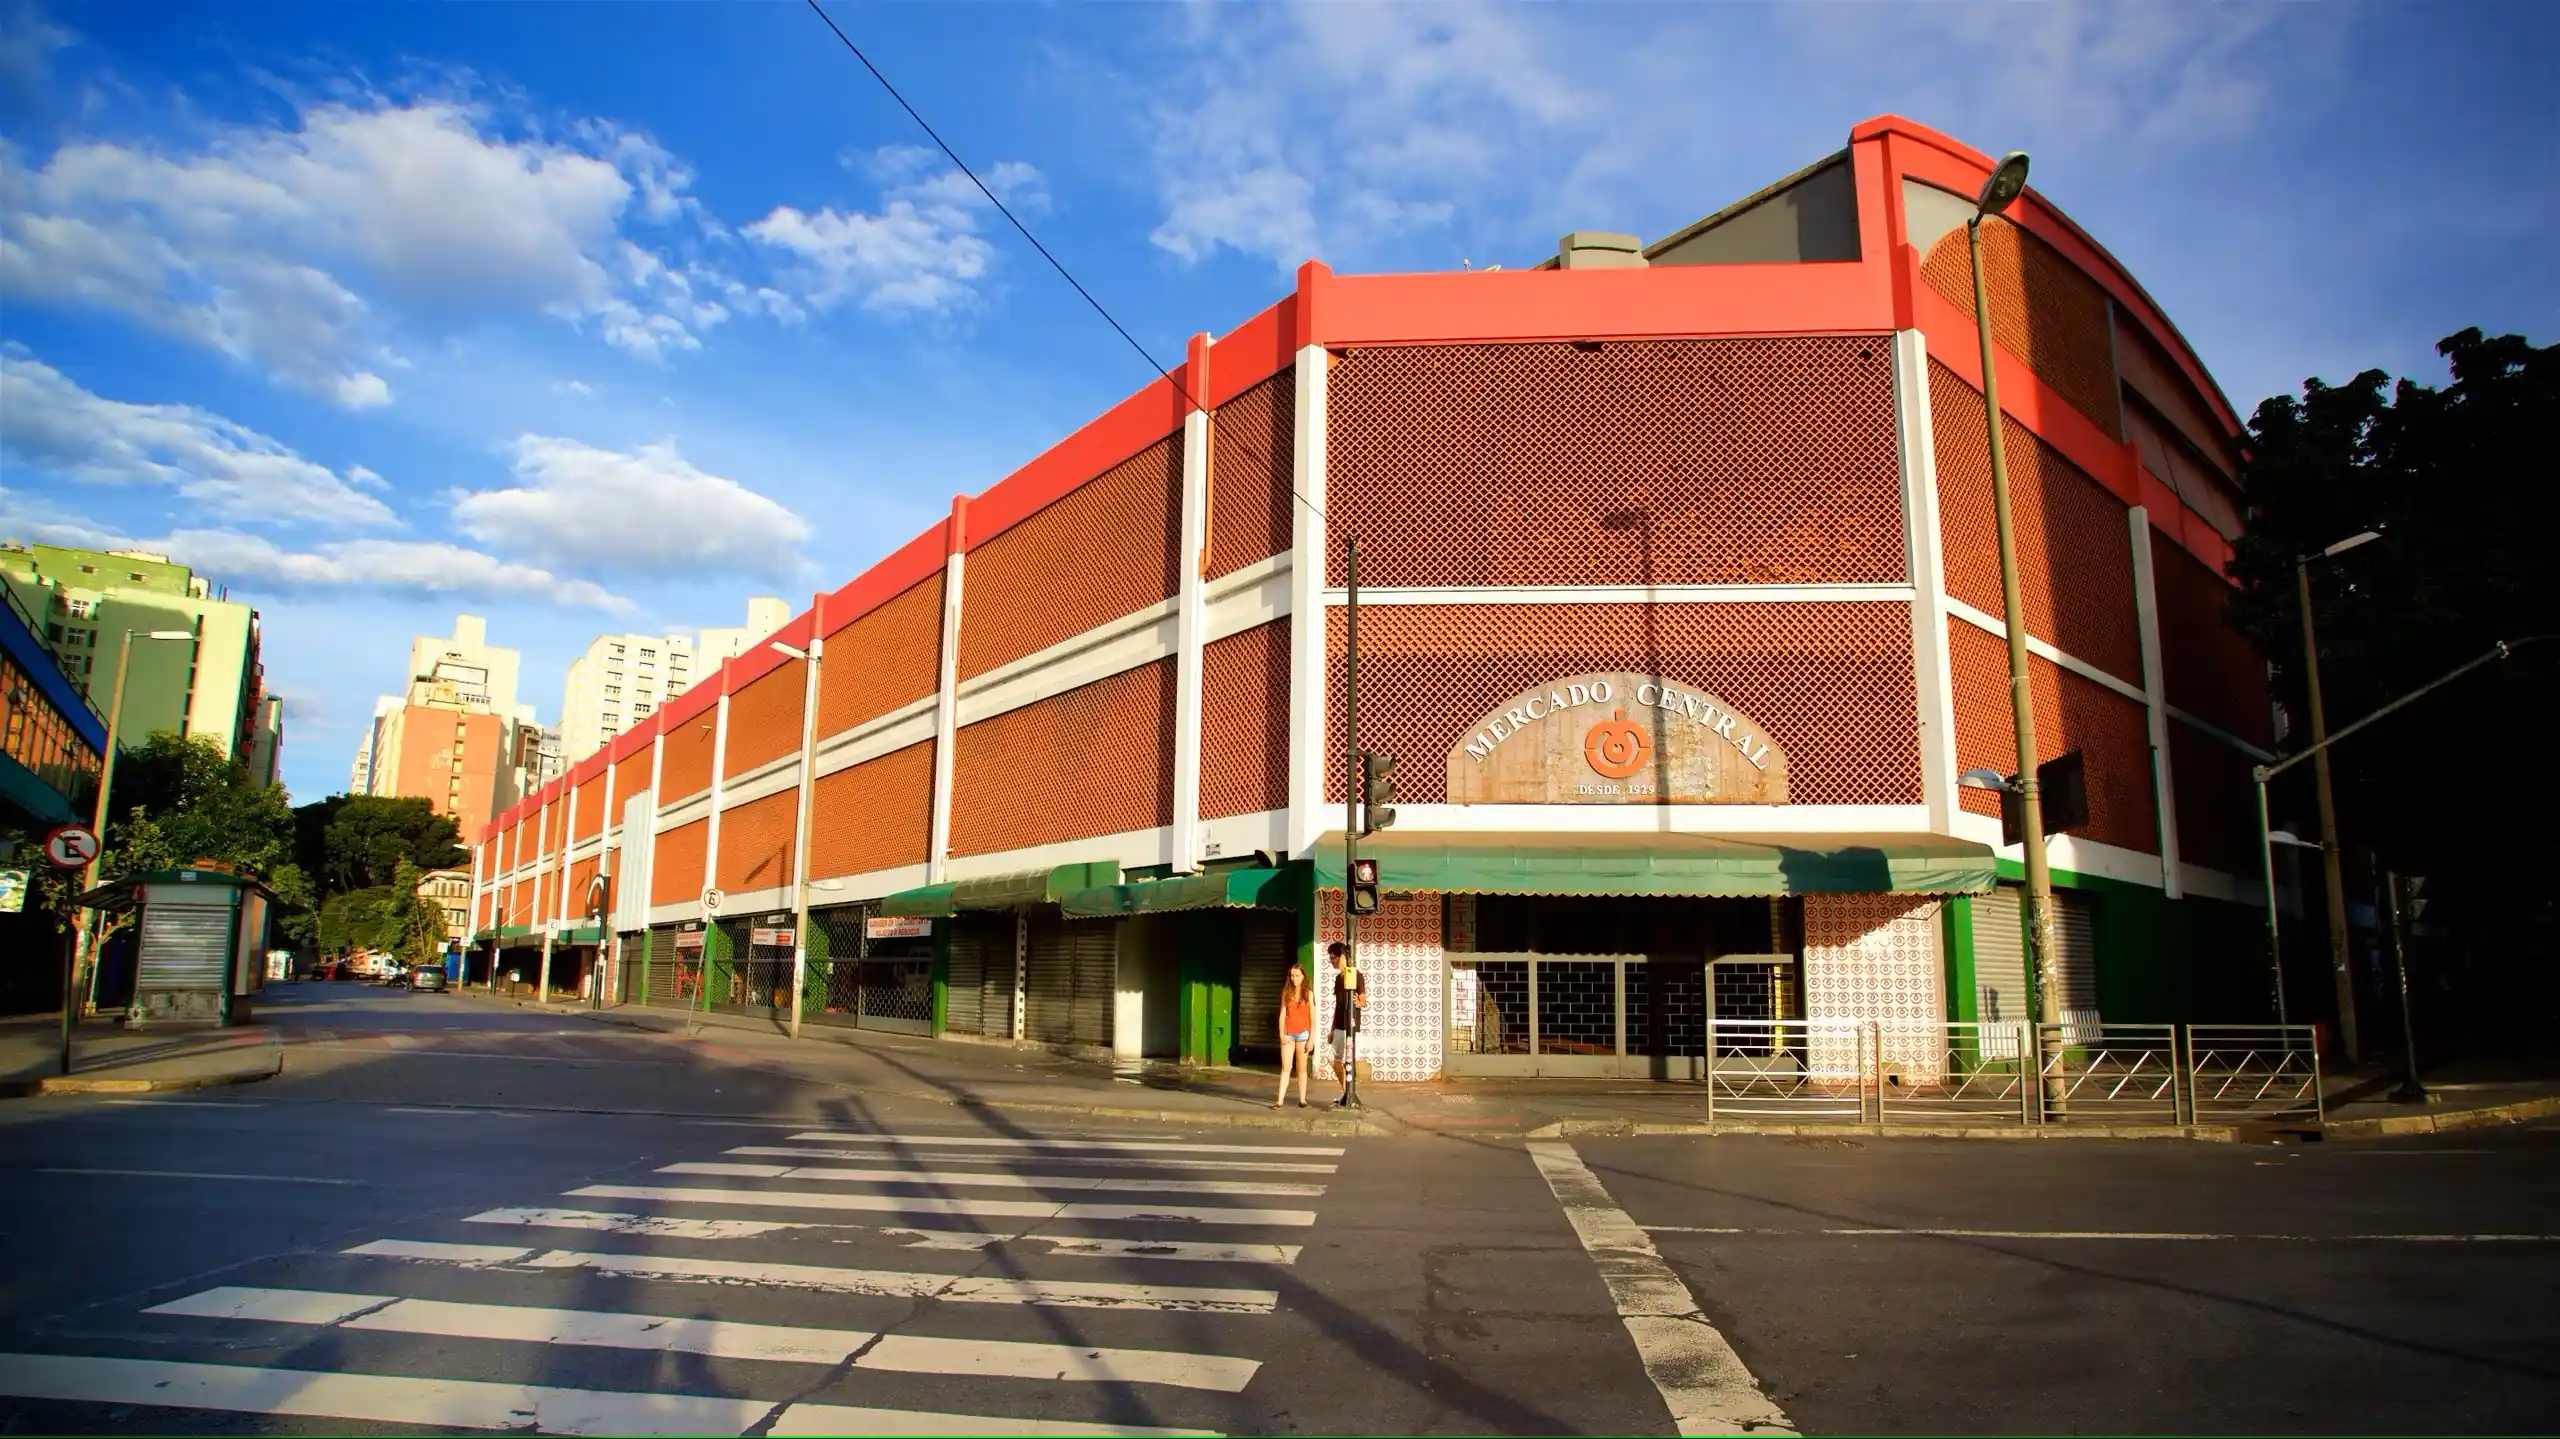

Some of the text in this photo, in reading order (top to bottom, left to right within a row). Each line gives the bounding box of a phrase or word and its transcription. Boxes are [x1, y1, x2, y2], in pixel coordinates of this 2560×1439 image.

[1464, 680, 1771, 771] MERCADO CENTRAL
[1579, 784, 1655, 795] DESDE 1929
[63, 836, 83, 858] E
